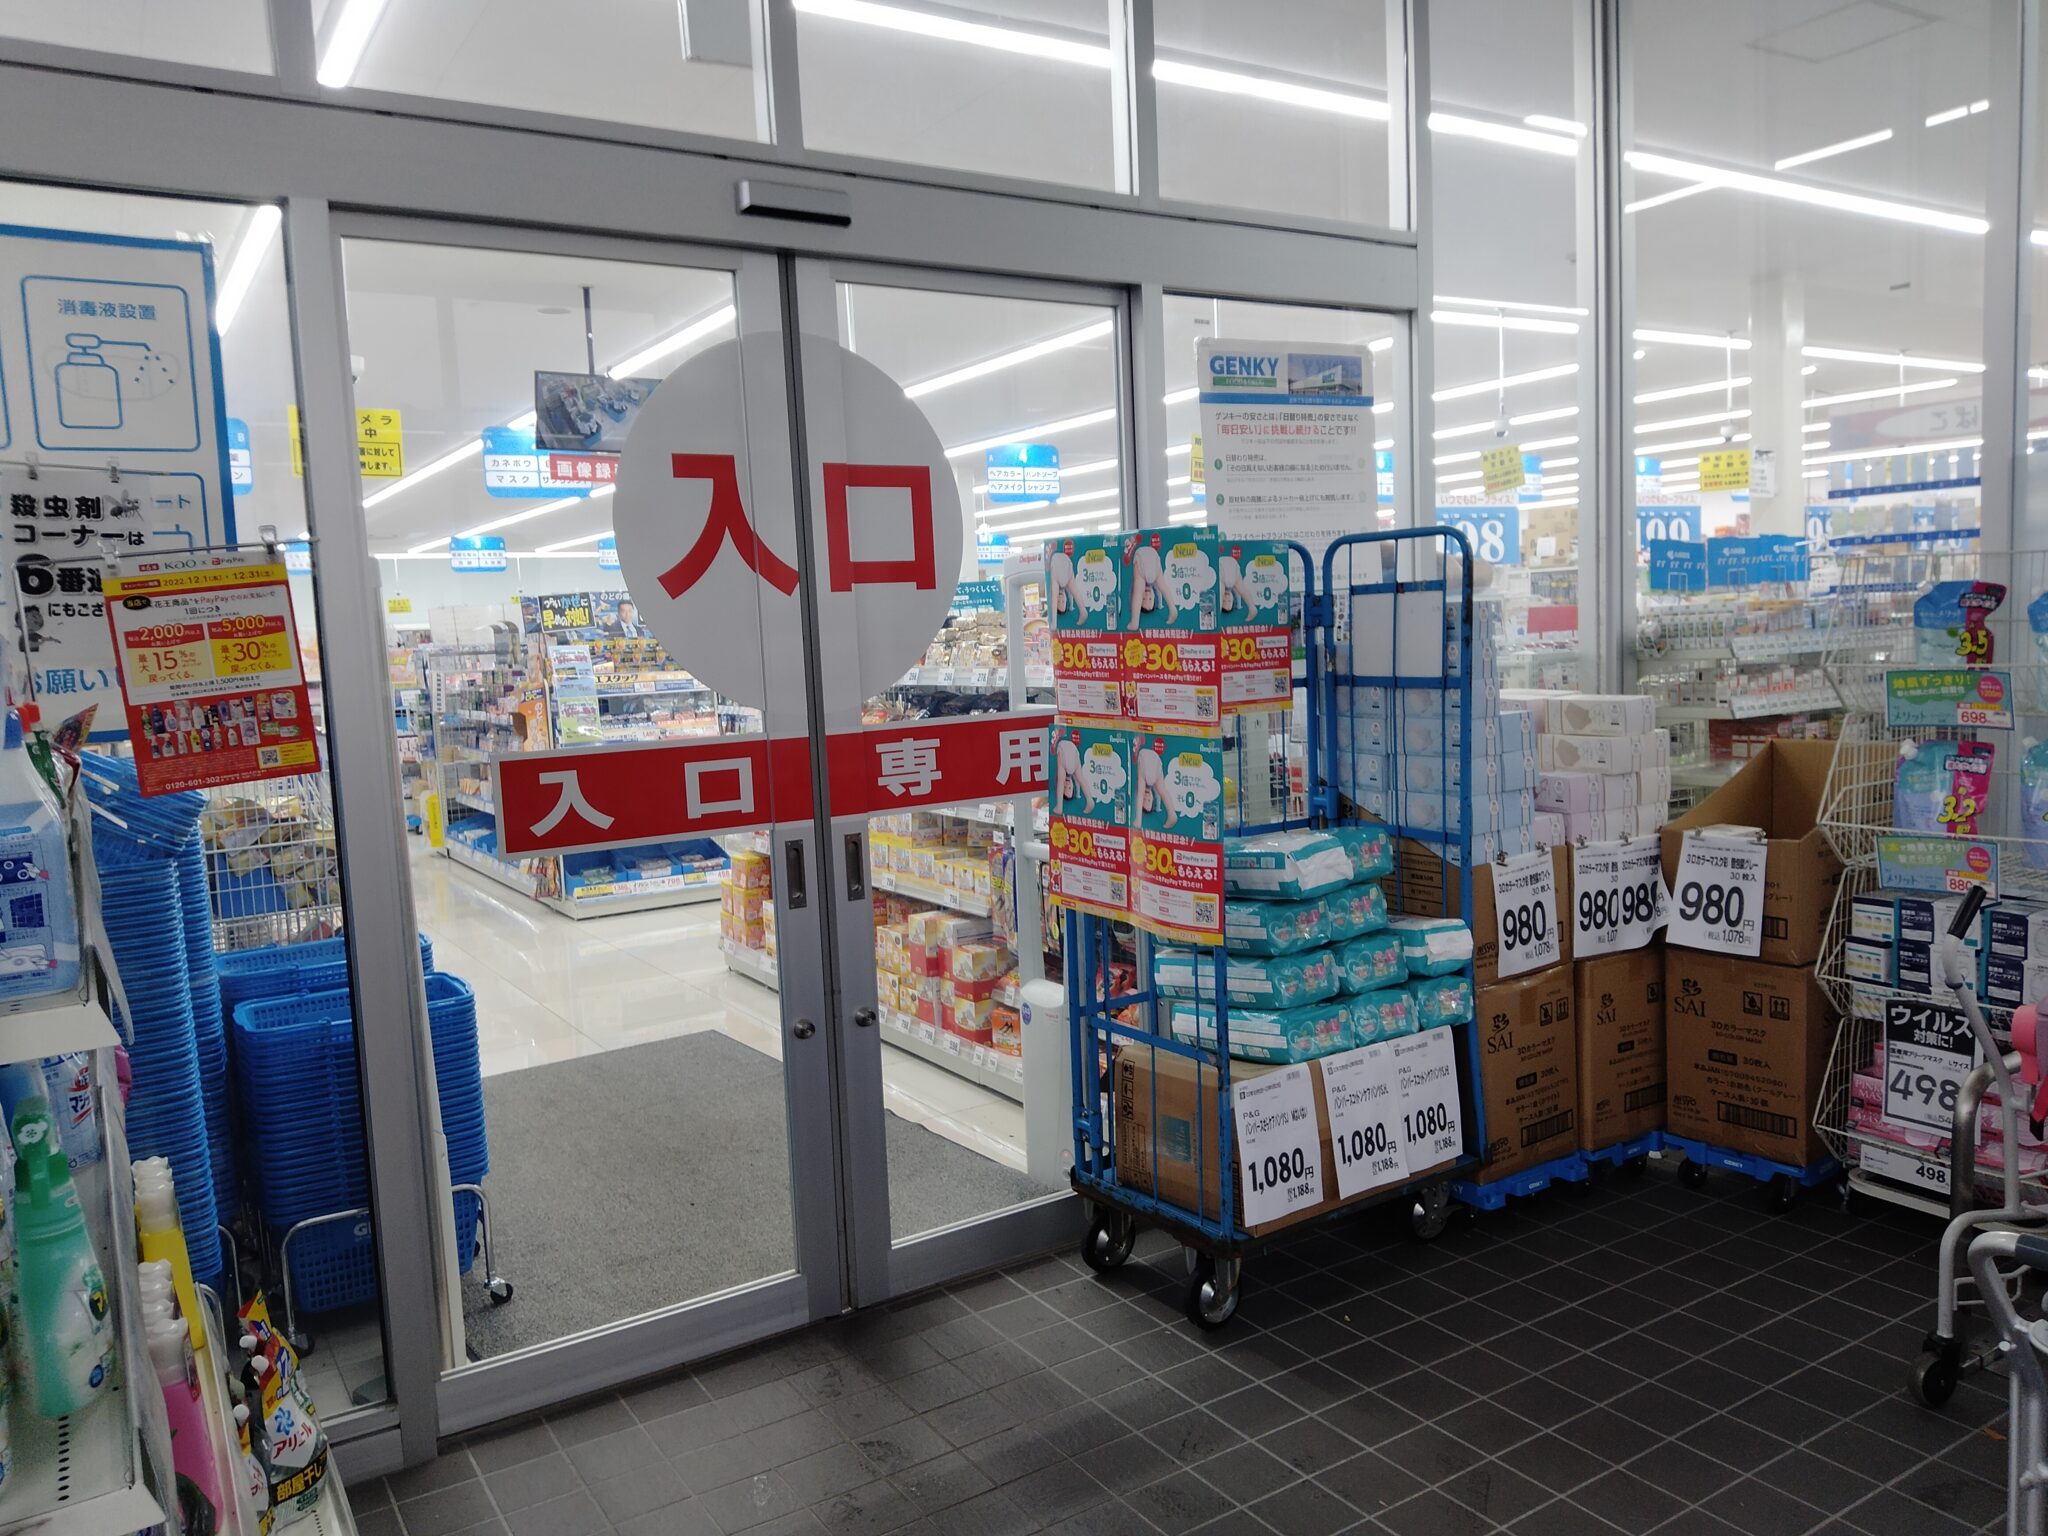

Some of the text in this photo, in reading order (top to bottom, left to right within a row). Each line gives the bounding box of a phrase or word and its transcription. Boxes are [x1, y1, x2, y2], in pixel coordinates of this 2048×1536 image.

[57, 298, 157, 321] 消毒液設置
[1210, 355, 1280, 377] GENKY
[365, 428, 377, 438] 中
[491, 458, 532, 467] カネボウ
[556, 460, 617, 479] 画像録
[496, 474, 530, 484] マスク
[10, 493, 103, 520] 殺虫剤
[14, 524, 146, 547] コーナーは
[657, 453, 936, 600] 入口
[220, 557, 245, 565] PayPay
[185, 605, 221, 615] 1回につき
[232, 641, 262, 662] 30
[1260, 648, 1289, 659] もらえる!
[153, 651, 178, 671] 15
[231, 662, 276, 673] 戻ってくる。
[1091, 657, 1118, 670] もらえる!
[1182, 659, 1216, 672] もらえる!
[148, 671, 195, 683] 戻ってくる。
[1961, 711, 1988, 724] 698
[166, 776, 221, 790] 0120-601-302
[1096, 847, 1126, 862] もらえる!
[1177, 864, 1218, 881] もらえる!
[1730, 872, 1740, 880] 30
[1579, 887, 1619, 932] 980
[1674, 997, 1707, 1018] SAI
[1596, 1008, 1616, 1026] SAI
[1890, 1005, 1973, 1039] ウイルス
[1711, 1020, 1766, 1038] 3Dカラーマスク
[1487, 1032, 1514, 1055] SAI
[1913, 1029, 1954, 1049] 対策に!
[1398, 1065, 1412, 1075] P&G
[1331, 1084, 1347, 1094] P&G
[1889, 1069, 1961, 1112] 498
[1242, 1109, 1261, 1120] P&G
[1403, 1102, 1456, 1146] 1,080円
[1337, 1122, 1397, 1167] 1,080円
[1248, 1147, 1315, 1195] 1,080円
[1916, 1164, 1946, 1183] 498
[272, 1422, 313, 1460] アリエール
